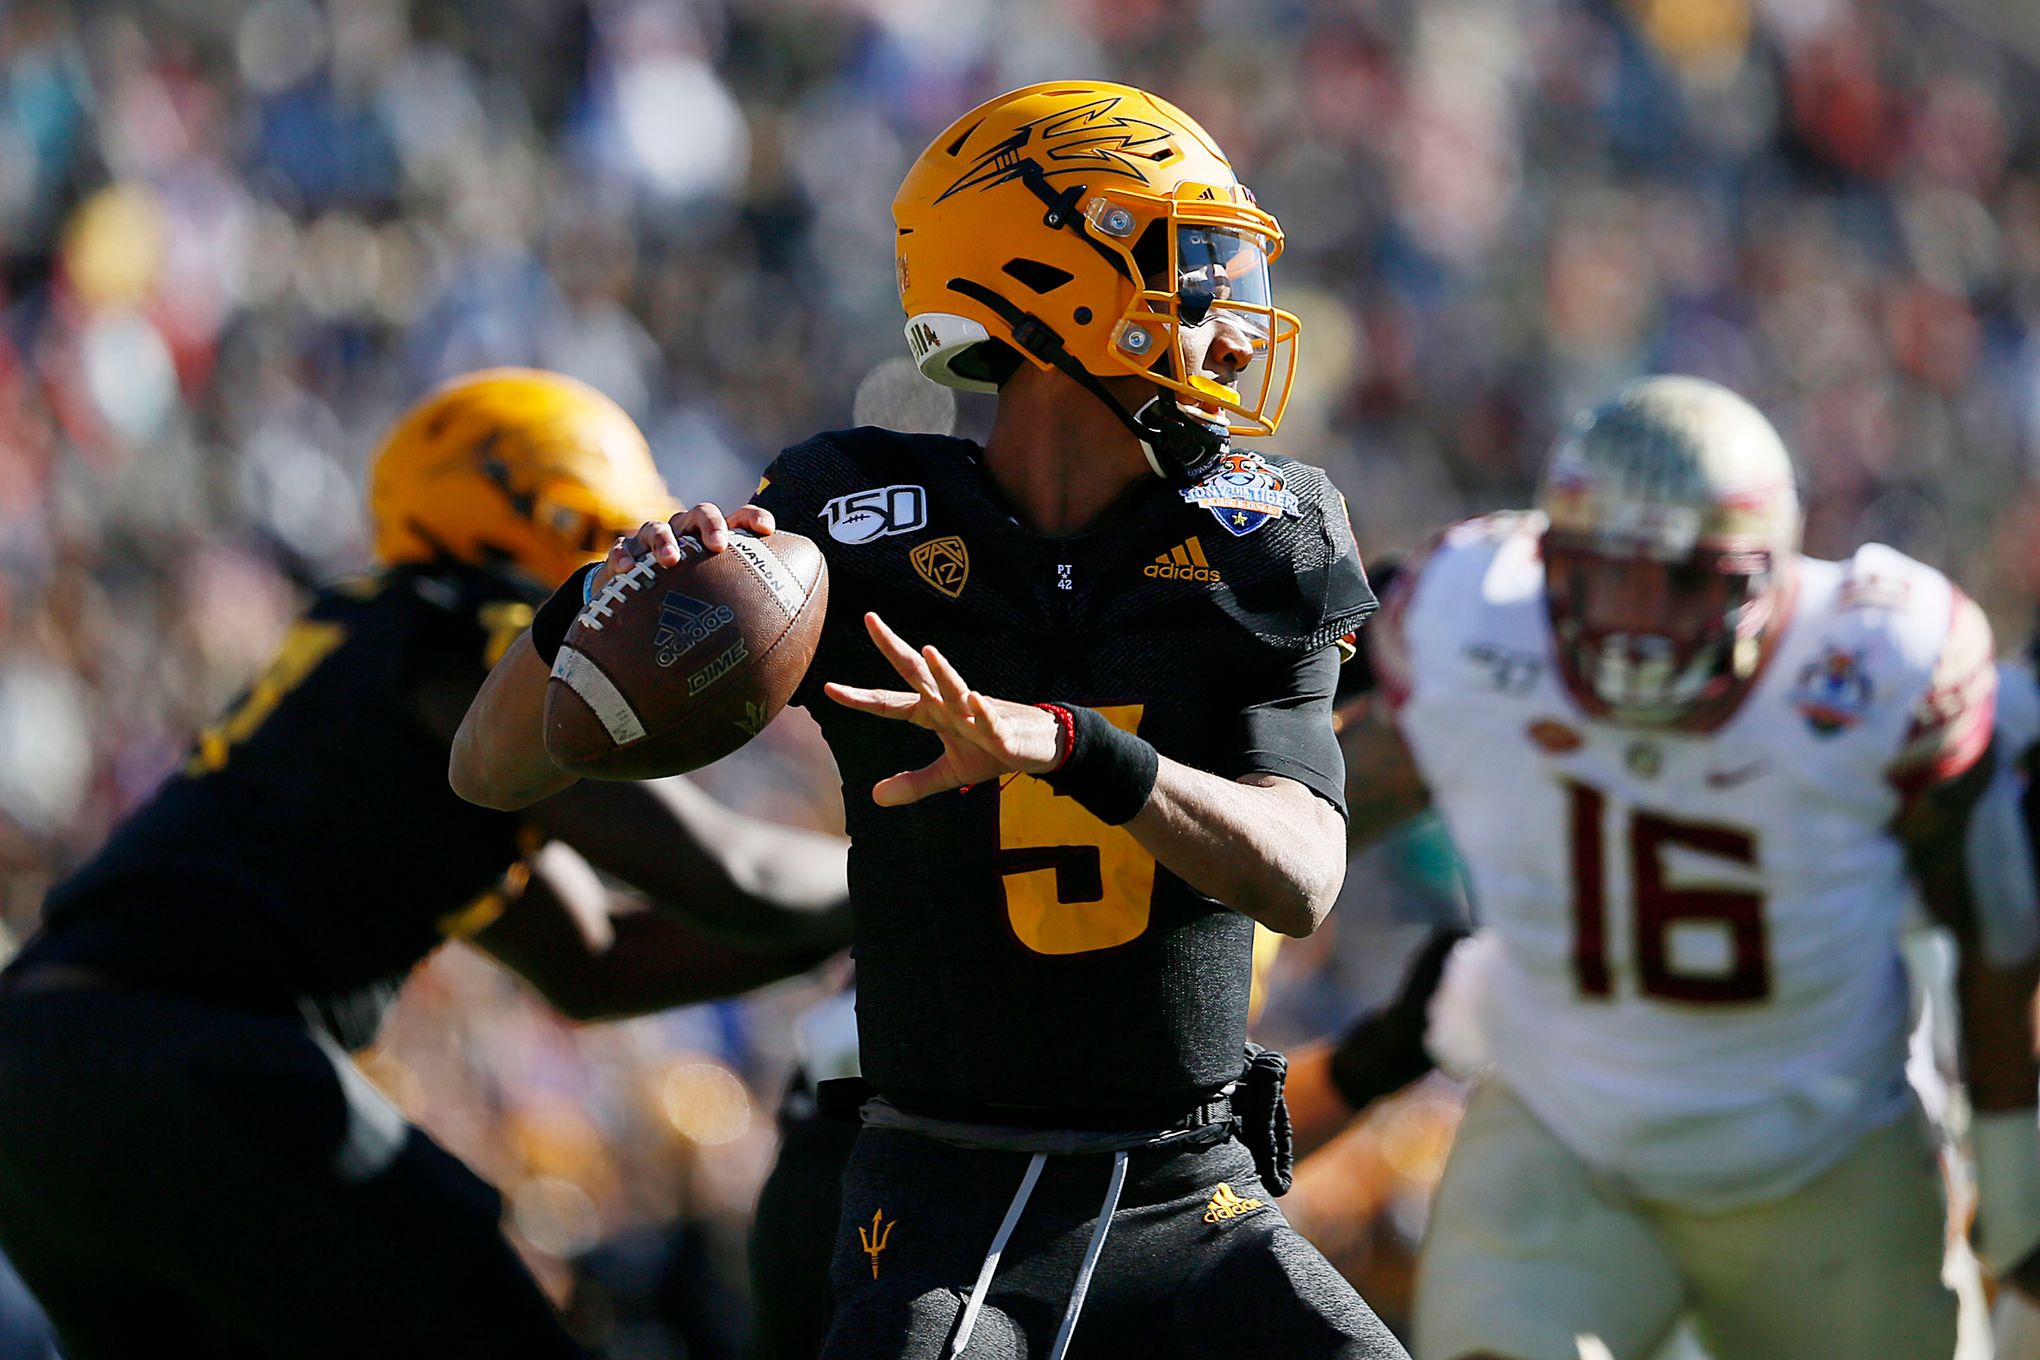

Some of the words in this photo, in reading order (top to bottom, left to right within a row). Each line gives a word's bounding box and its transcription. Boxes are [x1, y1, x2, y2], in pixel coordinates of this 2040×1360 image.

[825, 485, 926, 544] 150
[915, 539, 964, 577] PAC
[934, 562, 962, 586] 12
[1057, 564, 1073, 575] PT
[1143, 563, 1221, 582] adidas
[1057, 579, 1073, 590] 42
[656, 605, 734, 668] adidas
[688, 638, 749, 696] DIME
[996, 703, 1156, 955] 5
[1562, 774, 1773, 1010] 16
